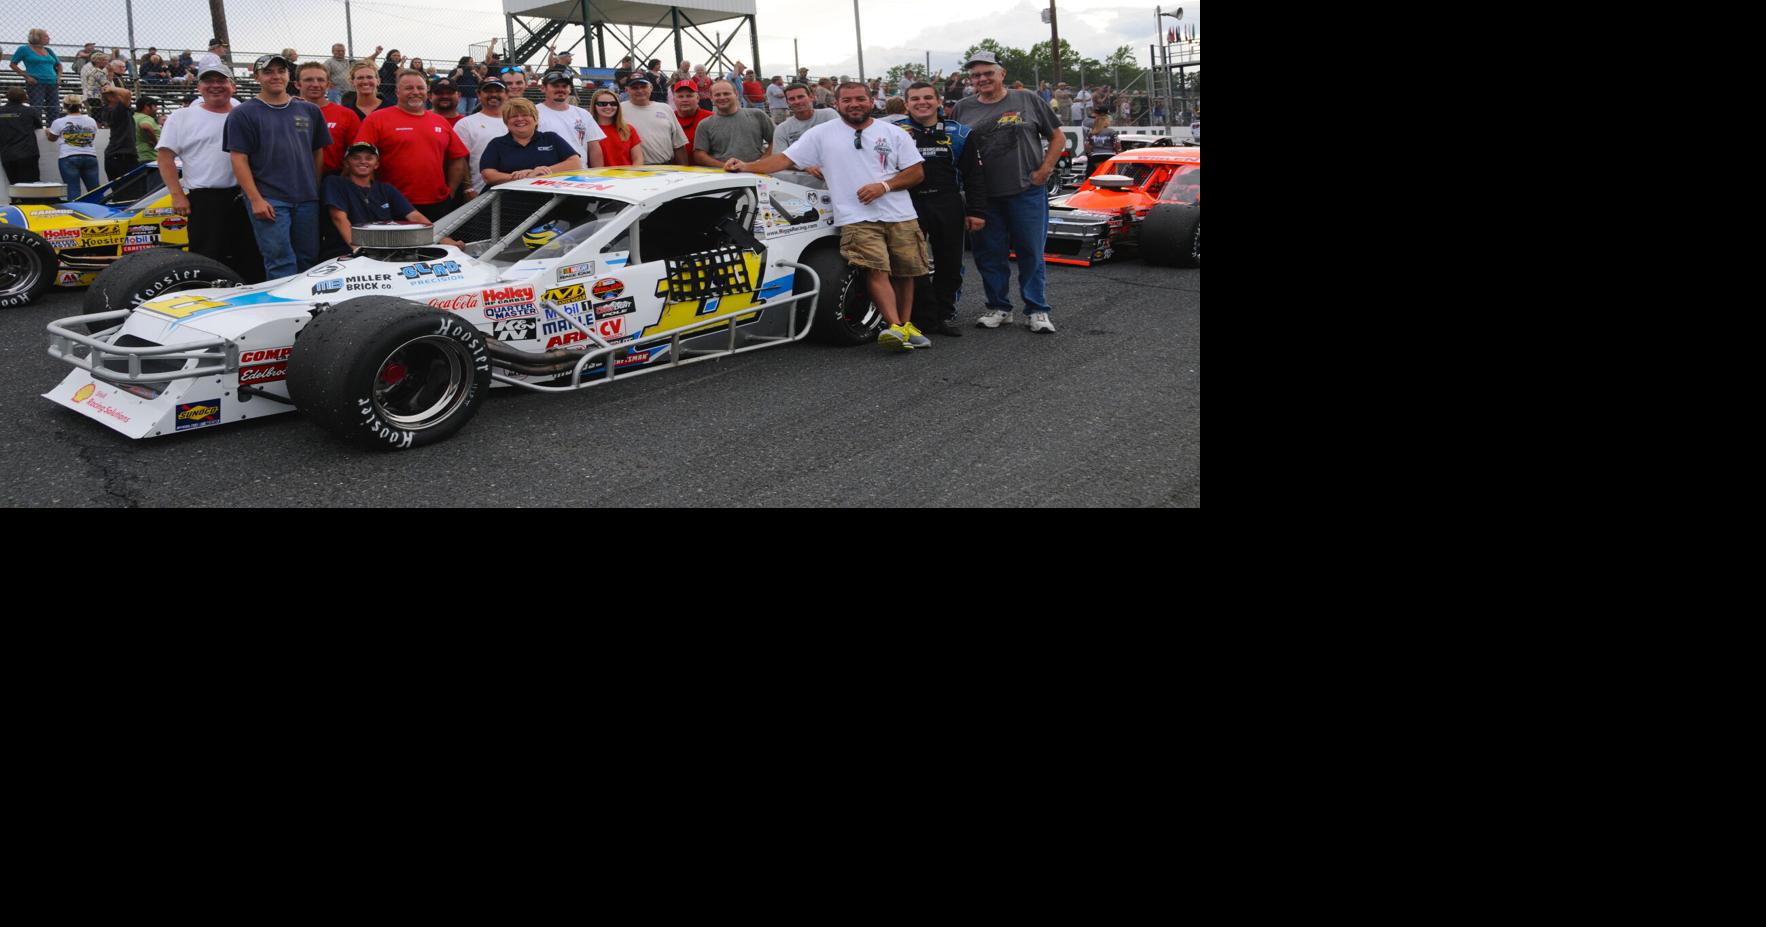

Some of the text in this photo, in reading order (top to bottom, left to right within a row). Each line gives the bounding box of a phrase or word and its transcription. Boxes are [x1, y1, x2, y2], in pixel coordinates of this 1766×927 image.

[2, 233, 40, 247] osier
[43, 229, 80, 238] Holley
[346, 273, 392, 283] MILLER
[409, 275, 464, 286] PRECISION
[131, 269, 201, 306] Hoosier
[346, 282, 379, 291] BRICK
[482, 287, 534, 302] Holley
[485, 303, 533, 316] QUARTER
[495, 309, 536, 319] MASTER
[545, 302, 579, 319] Mbil
[600, 318, 622, 337] CV
[434, 318, 489, 372] Hoosier
[241, 347, 293, 363] COMP
[241, 366, 288, 381] Edelbroc
[104, 406, 132, 423] Solutions
[178, 405, 219, 420] SUNOCO
[358, 398, 416, 448] Hoosier
